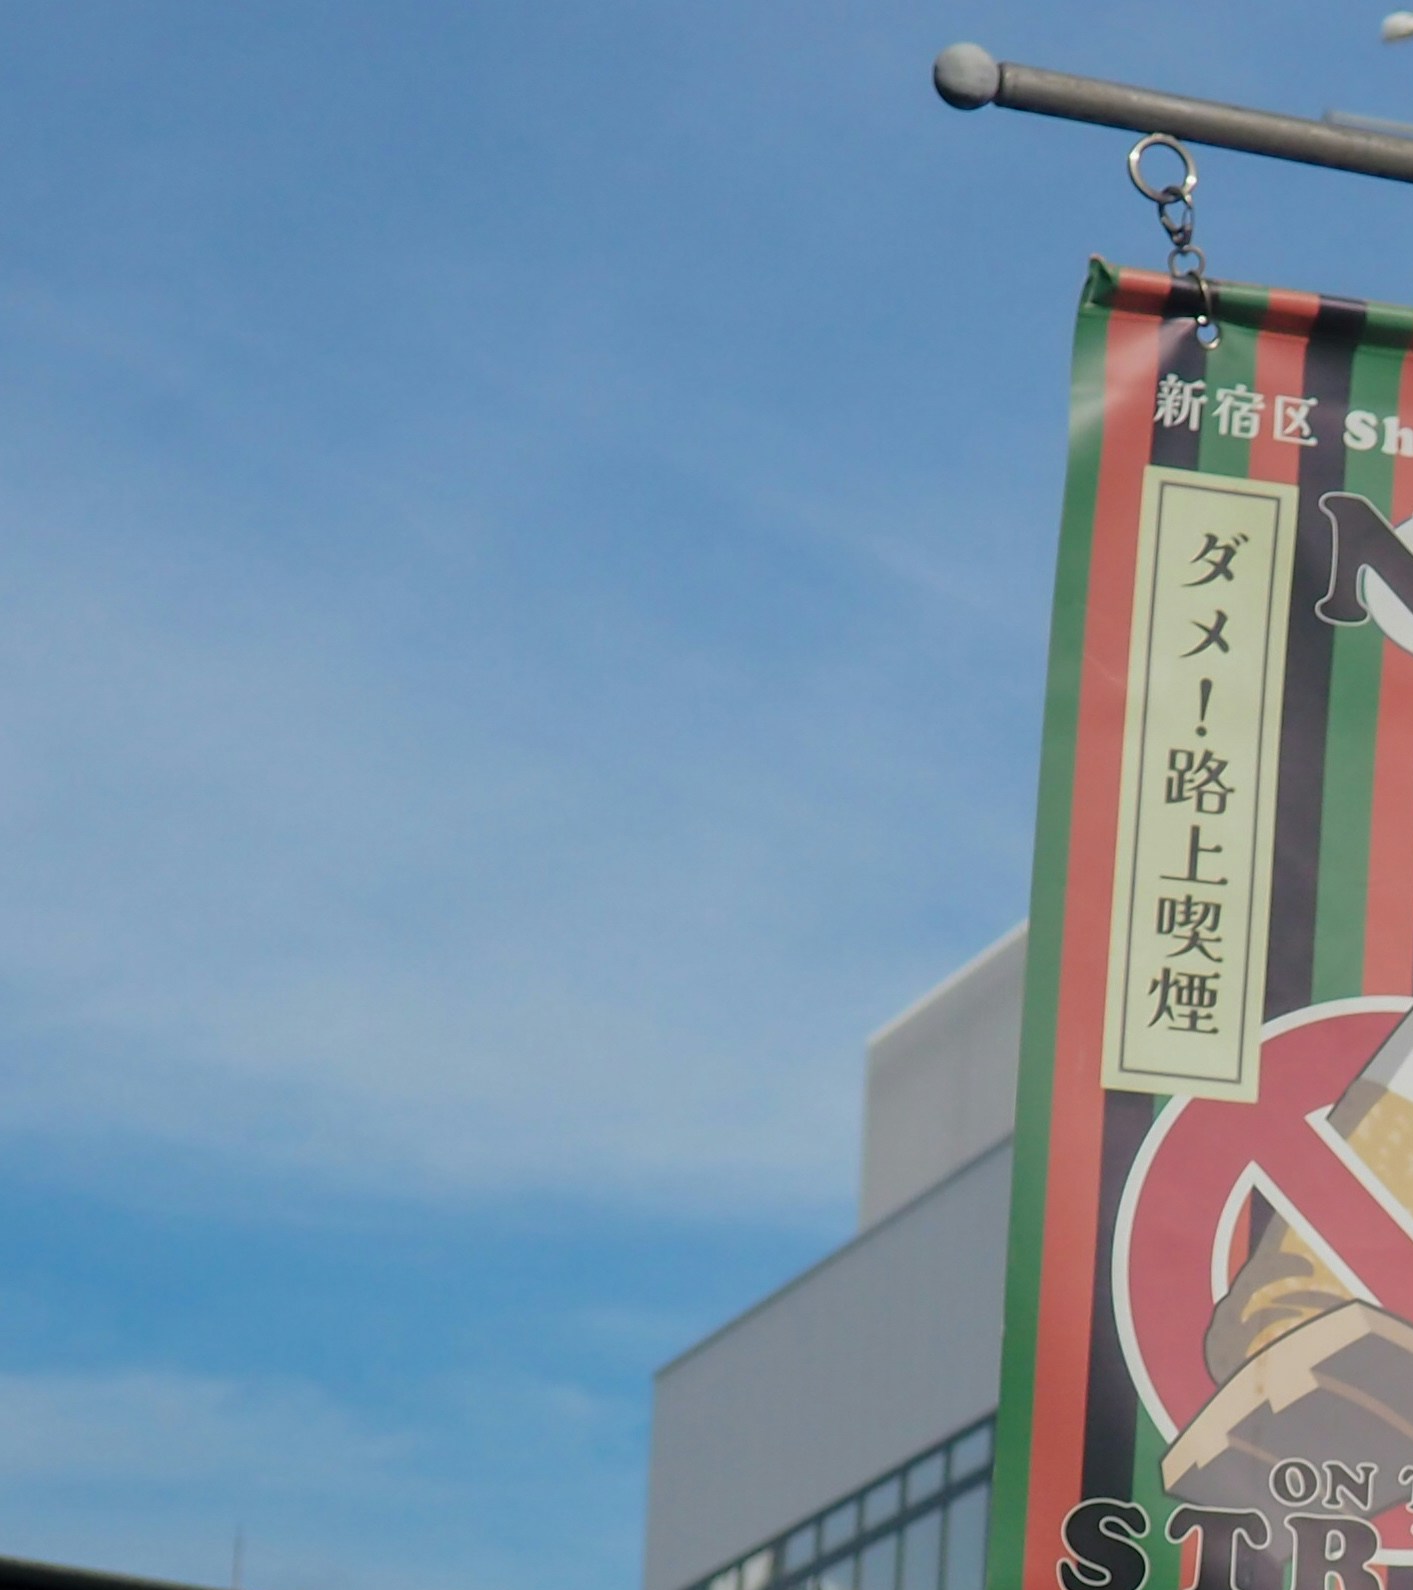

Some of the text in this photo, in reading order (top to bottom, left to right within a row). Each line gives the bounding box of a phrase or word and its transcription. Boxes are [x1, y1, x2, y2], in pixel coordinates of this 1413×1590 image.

[1152, 372, 1320, 448] 新宿区
[1268, 1456, 1379, 1512] ON
